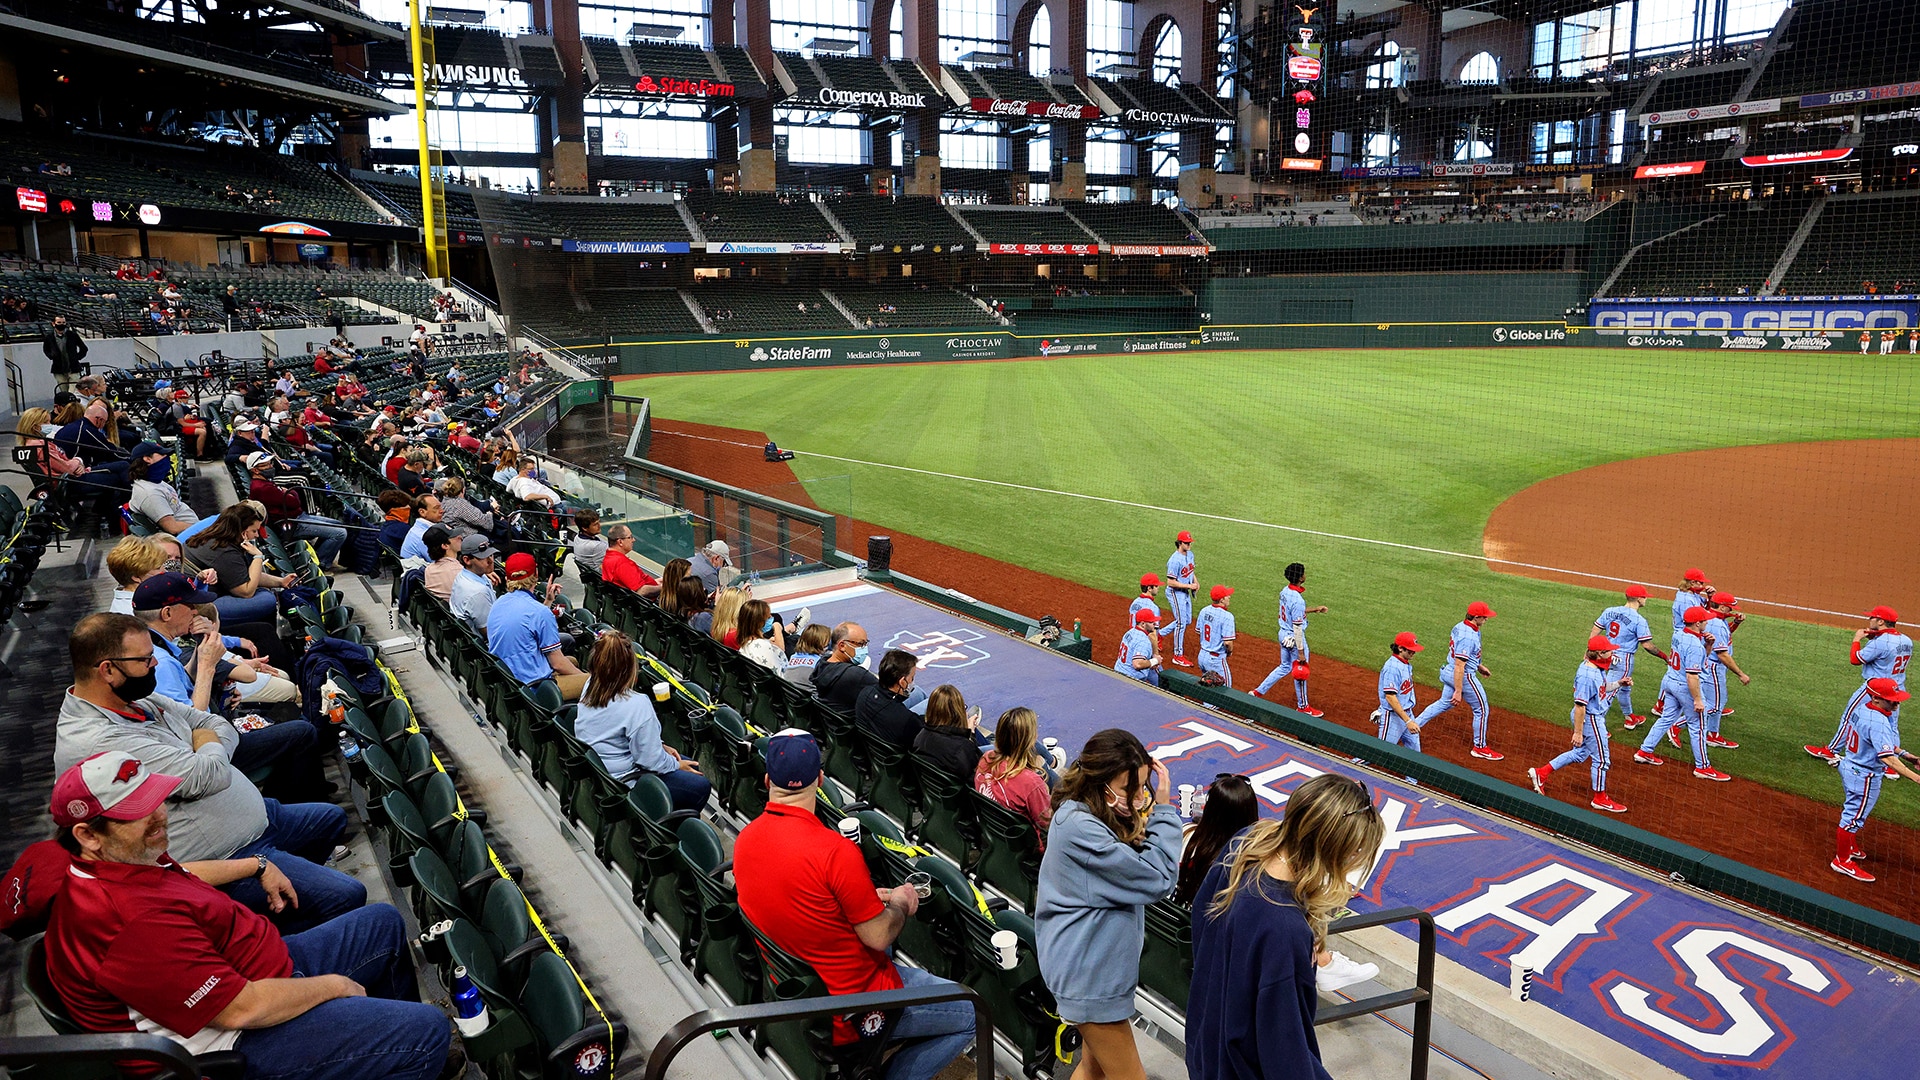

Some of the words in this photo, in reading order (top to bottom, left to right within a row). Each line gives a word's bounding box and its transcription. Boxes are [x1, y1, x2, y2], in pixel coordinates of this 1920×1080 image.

[422, 62, 520, 84] SAMSUNG
[889, 91, 926, 107] Bank
[1829, 90, 1866, 103] 105.3
[1869, 85, 1899, 99] THE
[1132, 108, 1191, 124] CHOCTAW
[1892, 144, 1919, 156] TCU
[1446, 166, 1472, 174] QuikTrip
[1486, 165, 1511, 173] QuikTrip
[1525, 164, 1576, 173] PLUCKERS
[735, 244, 777, 253] Albertsons
[791, 243, 805, 251] Tom
[805, 243, 827, 251] Thumb
[1113, 245, 1159, 255] WHATABURGER
[1162, 245, 1206, 255] WHATABURGER
[1595, 311, 1732, 336] GEICO
[1743, 310, 1909, 337] GEICO
[1510, 330, 1543, 341] Globe
[1544, 329, 1565, 340] Life
[1645, 336, 1684, 346] Kubota
[1733, 336, 1763, 345] ARROW
[1794, 337, 1824, 345] ARROW
[951, 338, 1002, 348] CHOCTAW
[1132, 341, 1158, 352] planet
[1159, 340, 1187, 349] fitness
[847, 350, 872, 359] Medical
[872, 350, 886, 360] City
[887, 349, 921, 358] Healthcare
[18, 449, 31, 460] 07
[1204, 624, 1211, 642] 8
[1609, 621, 1620, 639] 9
[1150, 721, 1832, 1056] TEXAS
[584, 1051, 597, 1067] T
